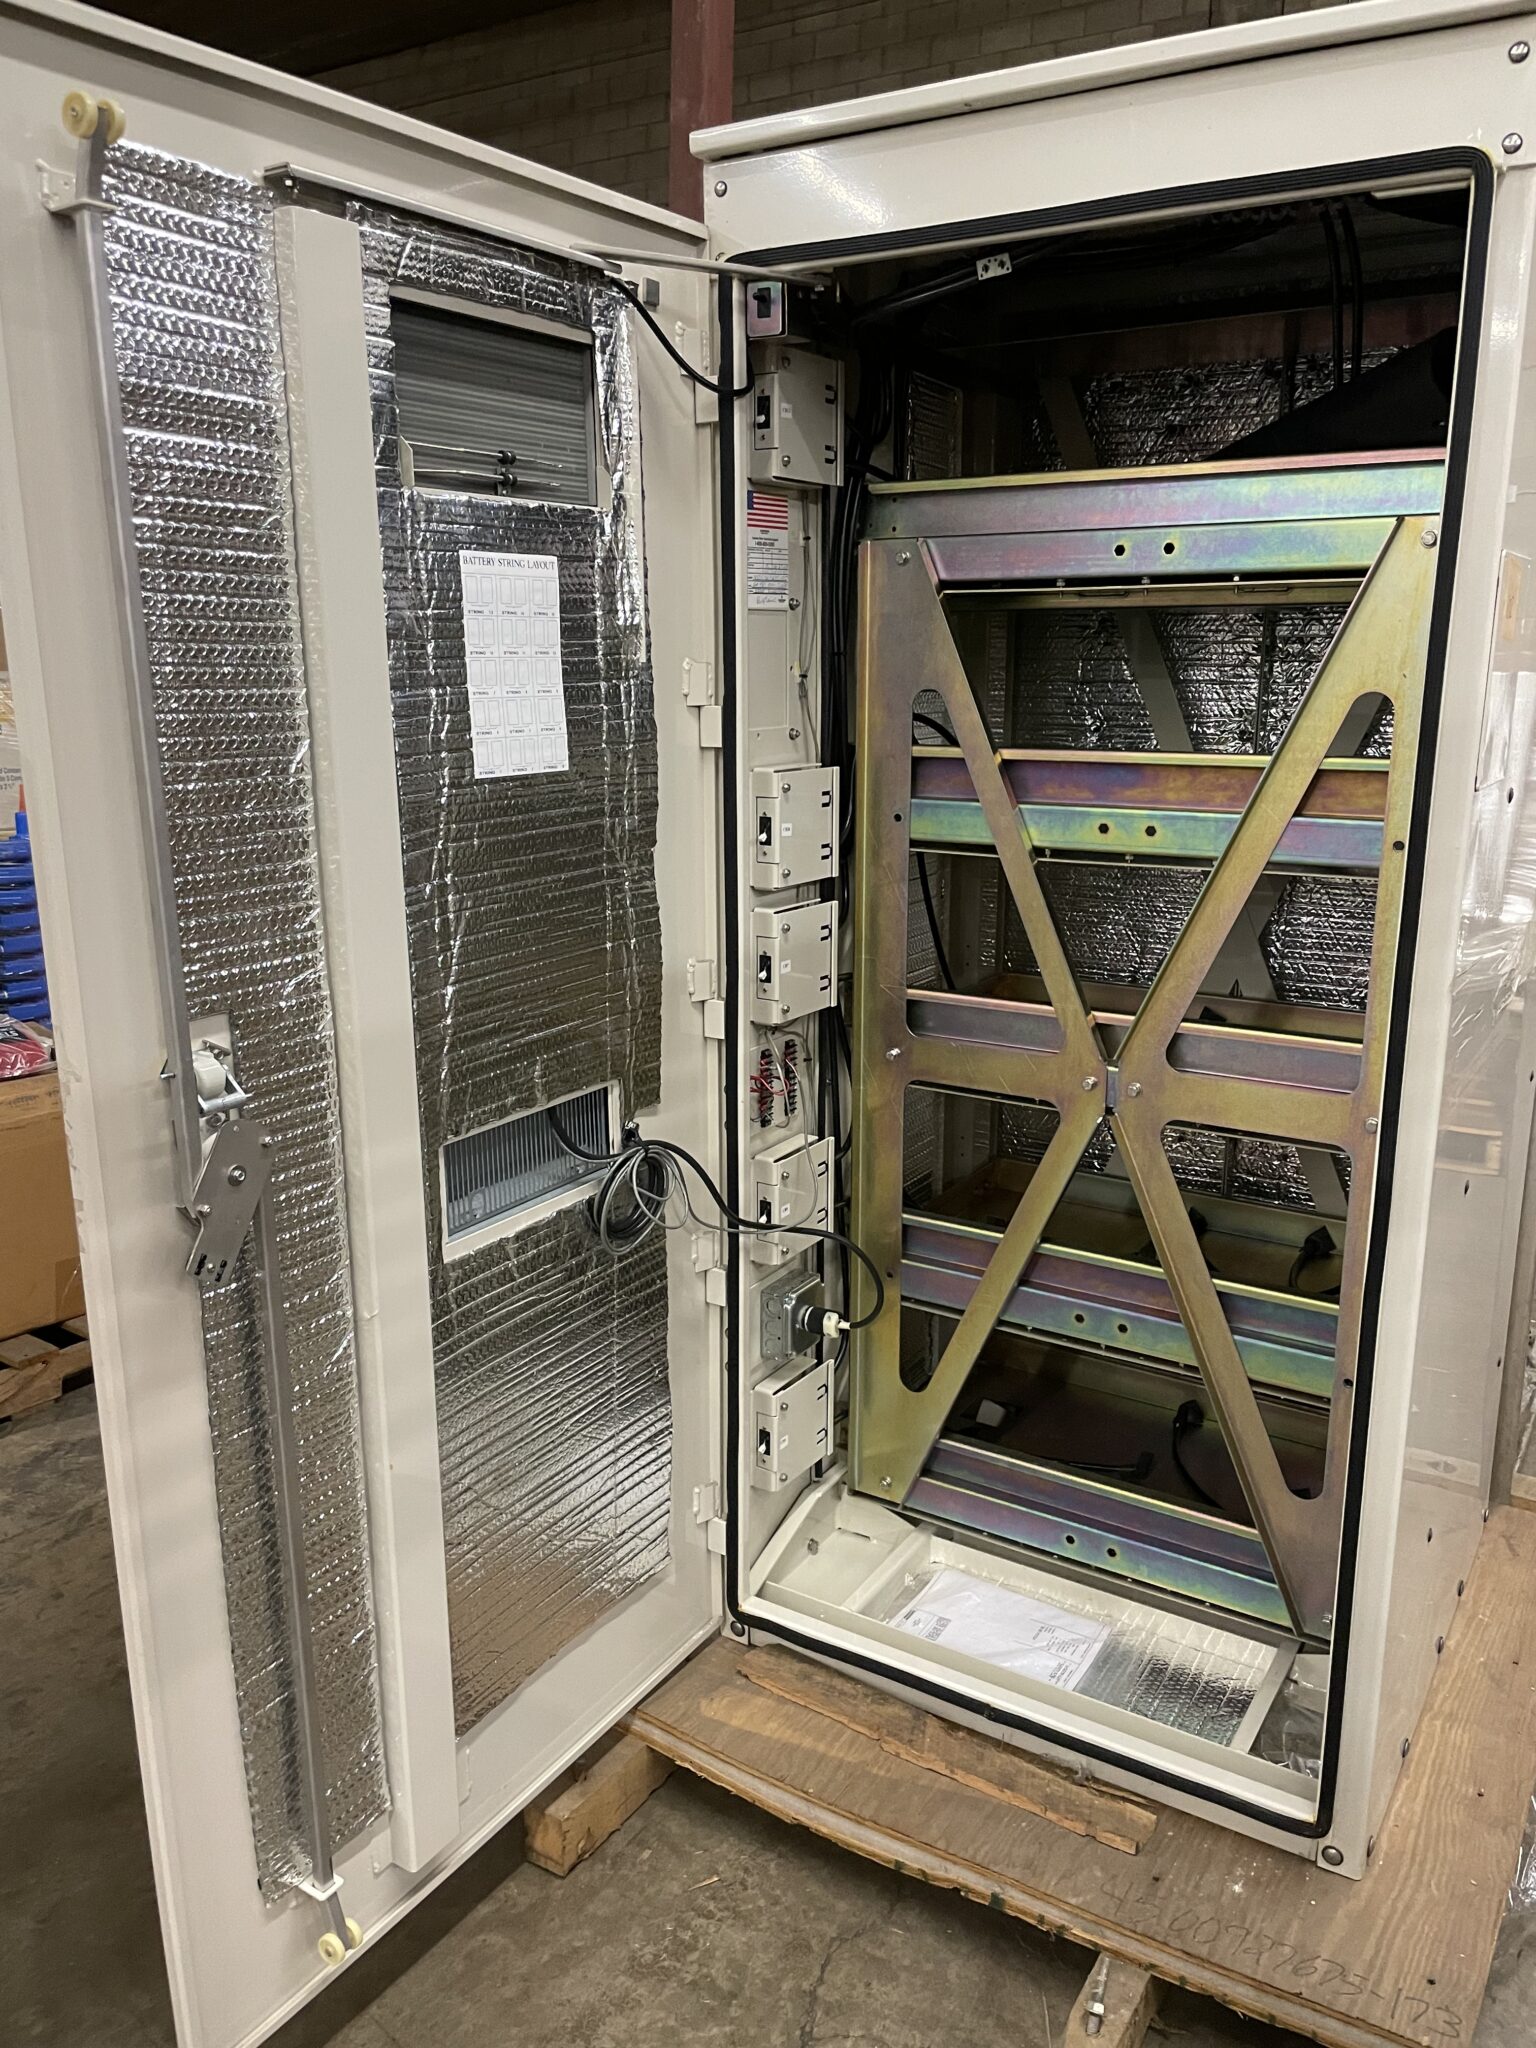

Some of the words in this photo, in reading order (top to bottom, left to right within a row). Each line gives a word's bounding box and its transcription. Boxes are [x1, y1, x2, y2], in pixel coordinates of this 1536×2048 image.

[462, 555, 496, 566] BATTERY
[497, 558, 526, 568] STRING
[527, 560, 556, 570] LAYOUT
